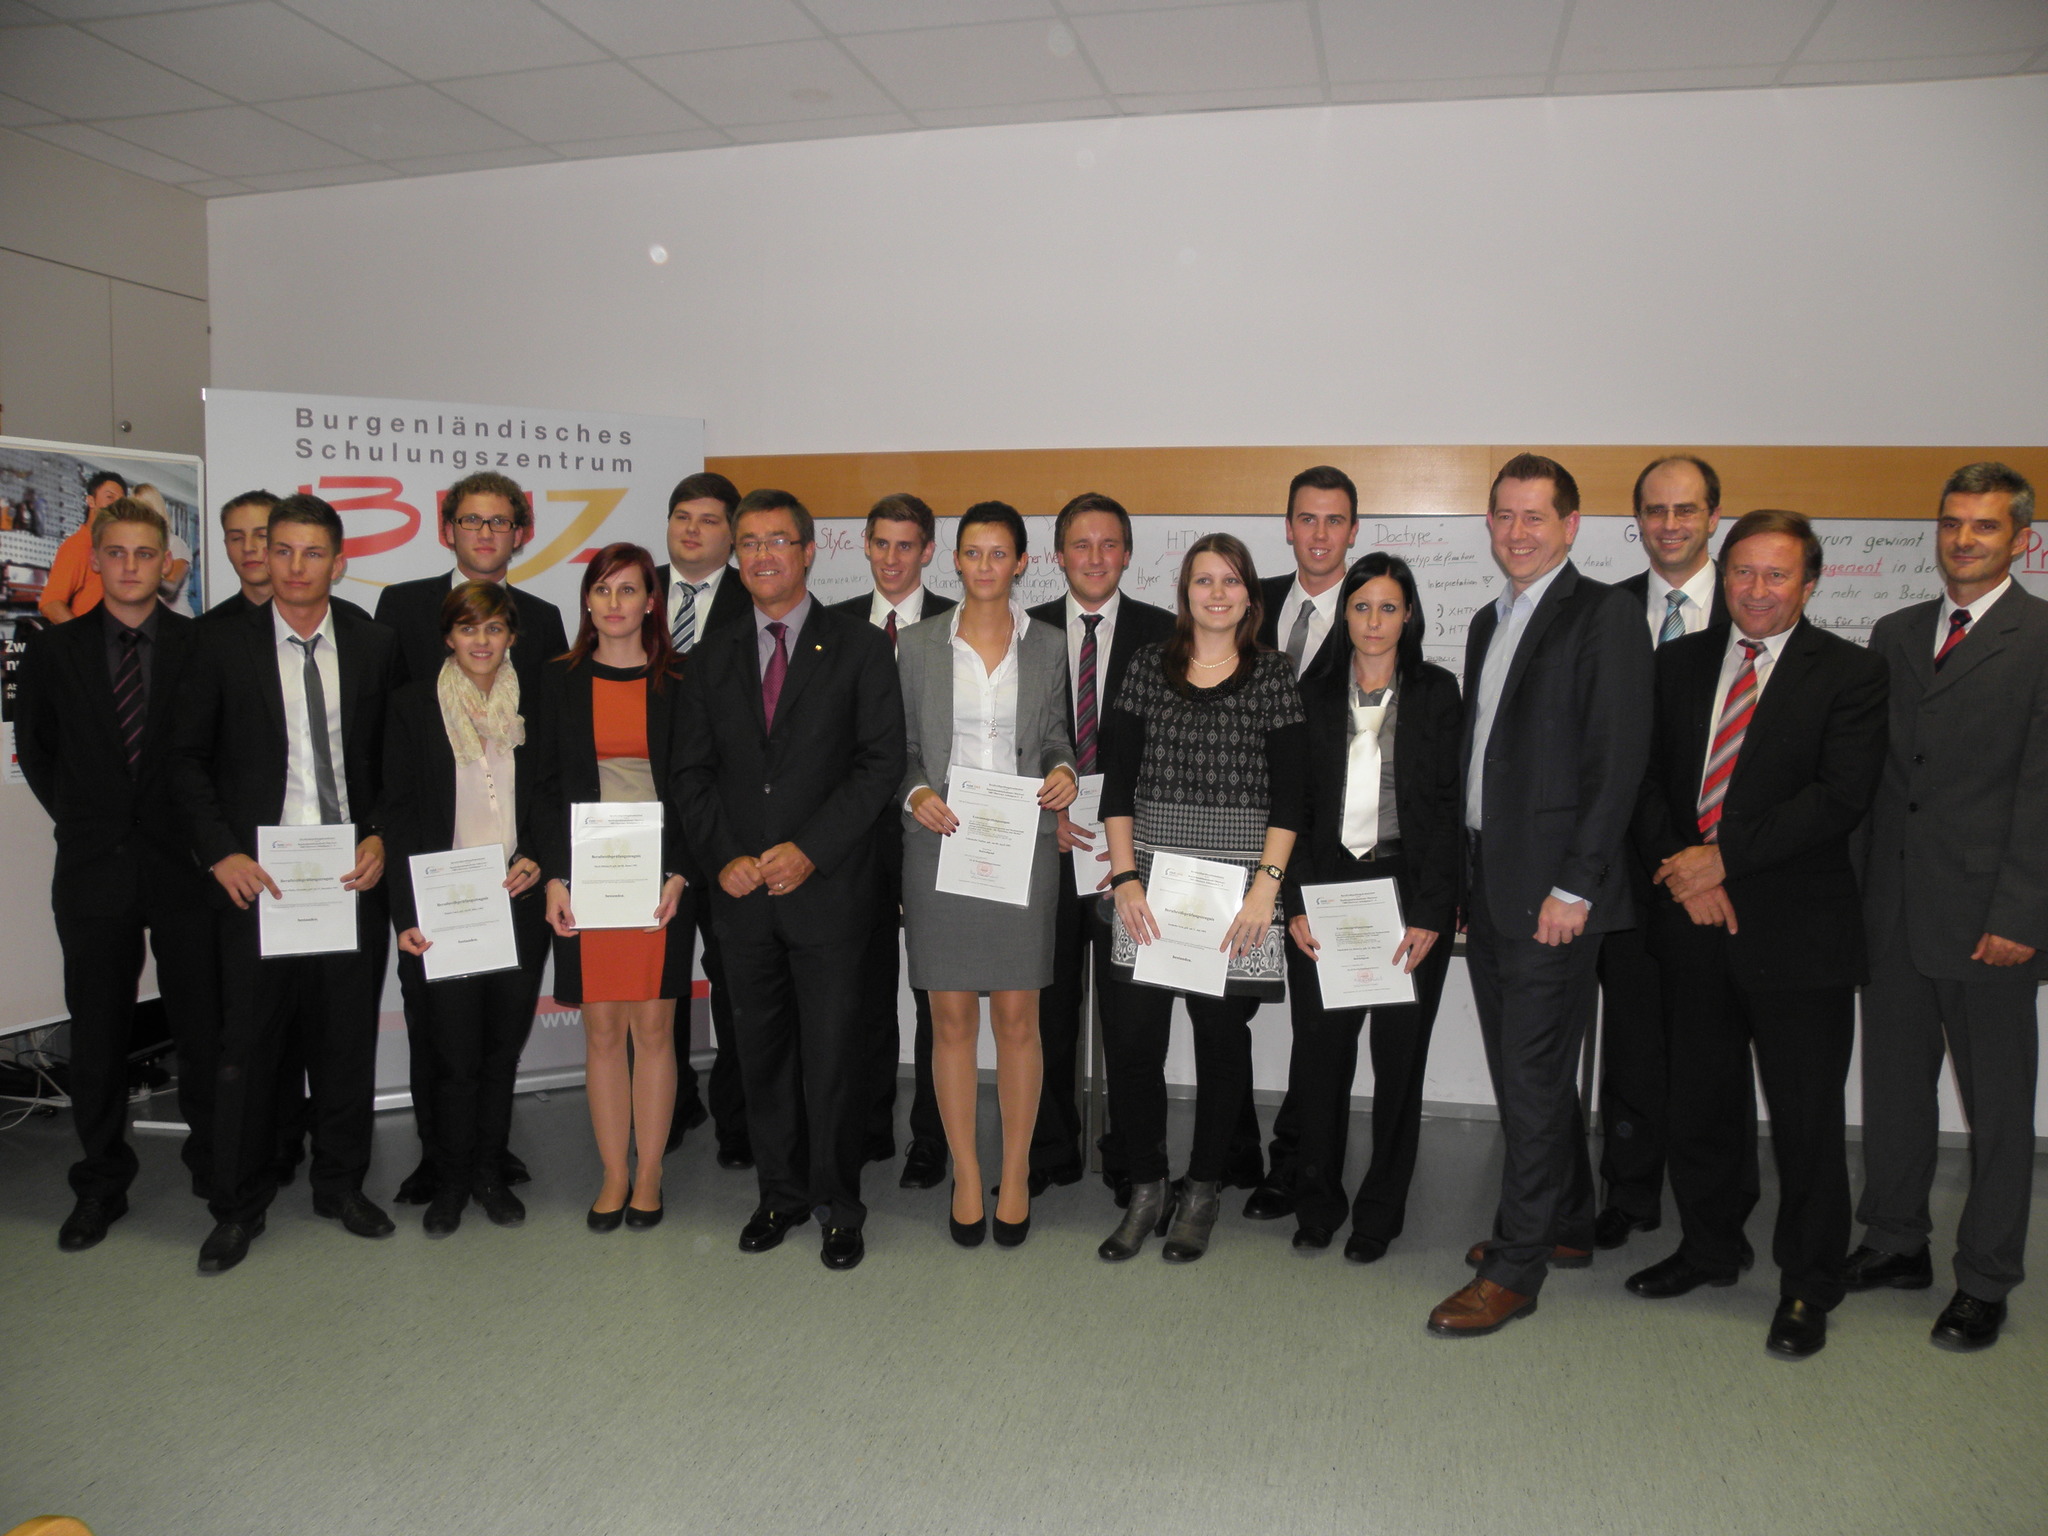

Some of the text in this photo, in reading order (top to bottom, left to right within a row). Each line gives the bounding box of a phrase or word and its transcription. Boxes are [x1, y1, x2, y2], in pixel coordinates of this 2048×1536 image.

[295, 407, 632, 446] Burgenländisches
[295, 437, 633, 473] Schulungszentrum
[816, 527, 854, 560] Style
[1863, 532, 1925, 553] gewinnt
[1892, 559, 1906, 574] in
[1873, 590, 1889, 599] an
